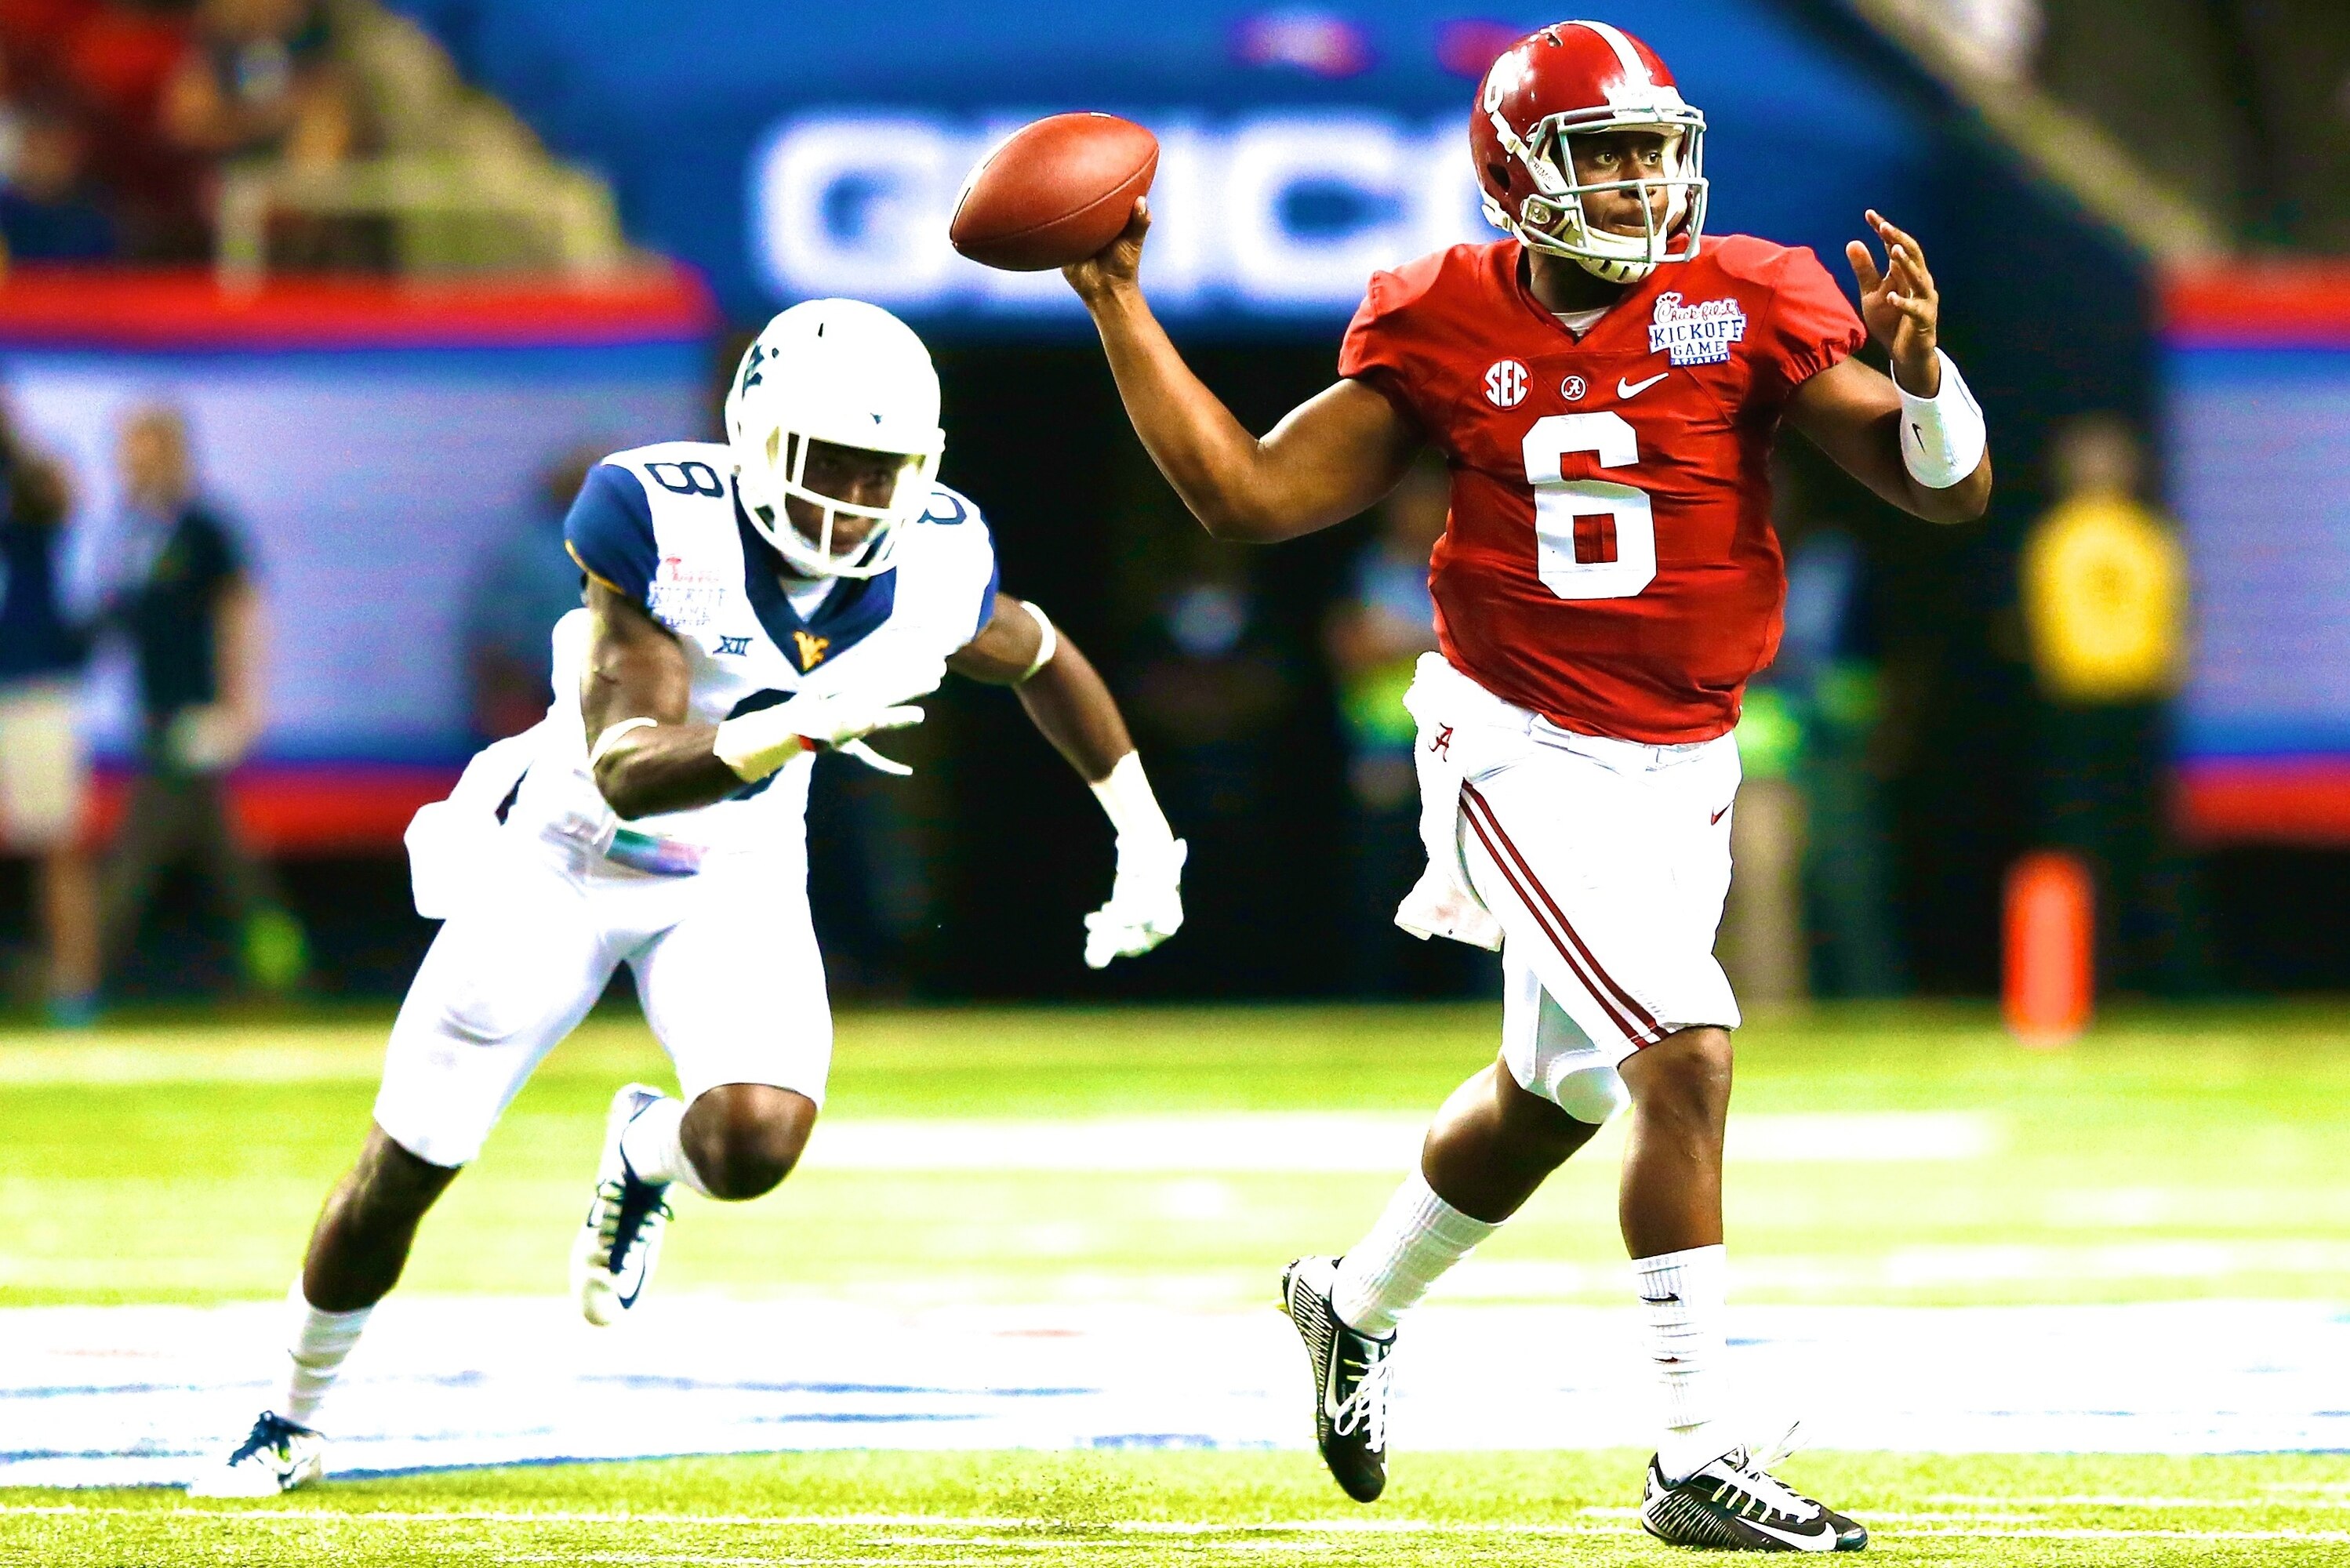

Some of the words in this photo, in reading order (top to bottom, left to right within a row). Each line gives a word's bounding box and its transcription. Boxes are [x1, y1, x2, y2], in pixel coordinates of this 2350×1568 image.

[754, 111, 1487, 304] GIC
[1652, 318, 1743, 349] KICKOFF
[1673, 340, 1724, 356] GAME
[1484, 360, 1528, 407] SEC
[644, 461, 725, 498] 8
[1522, 411, 1658, 600] 6
